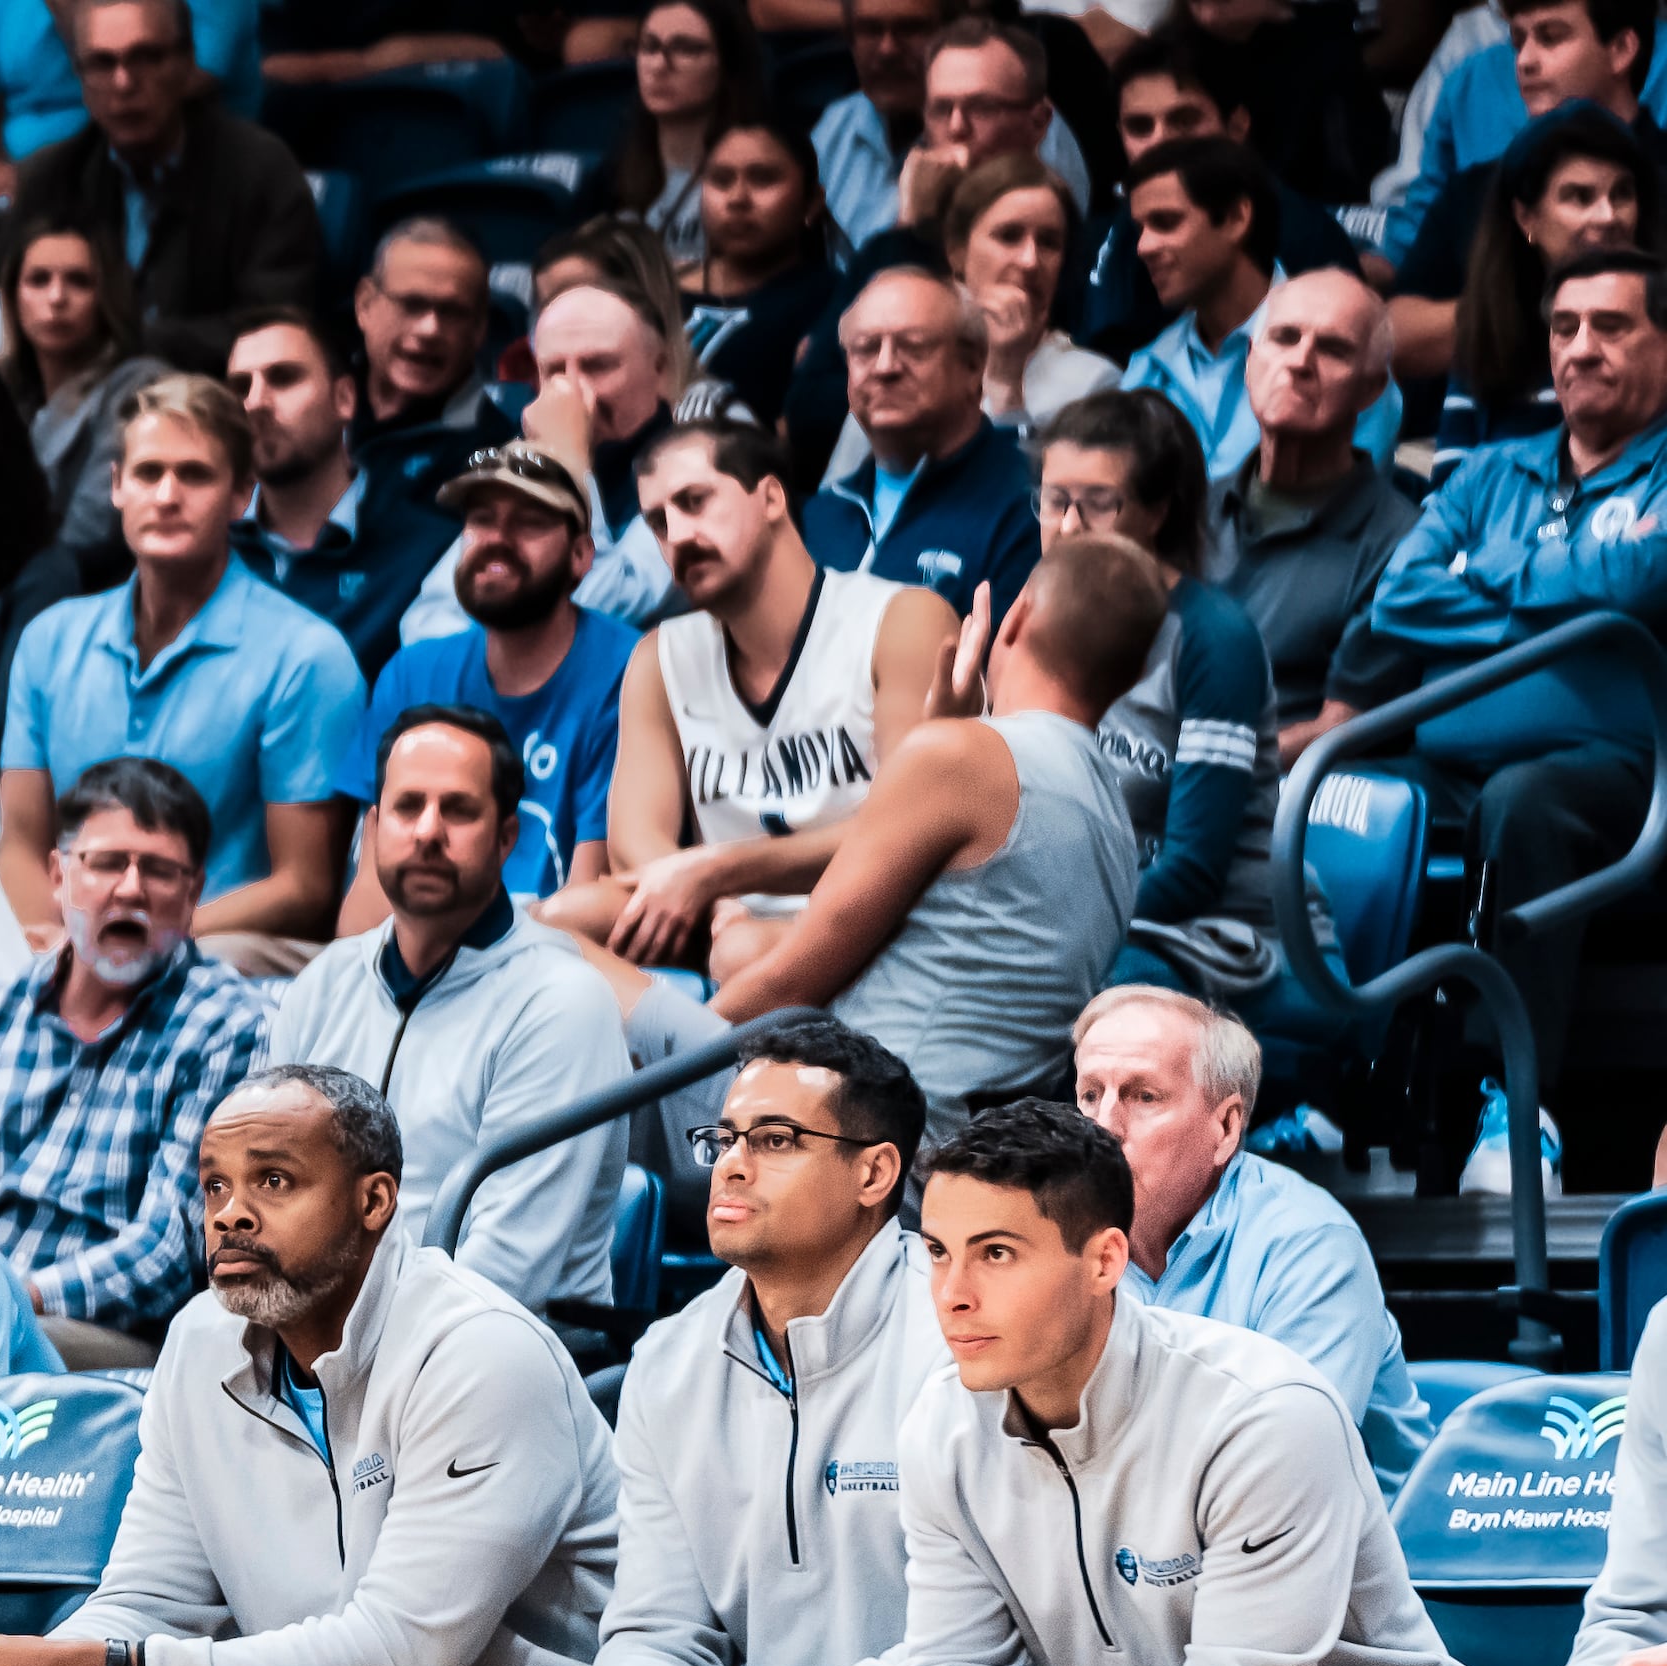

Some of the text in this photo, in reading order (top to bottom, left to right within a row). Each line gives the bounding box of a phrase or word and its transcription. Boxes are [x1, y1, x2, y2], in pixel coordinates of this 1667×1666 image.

[1446, 1471, 1518, 1498] Main
[1518, 1470, 1582, 1498] Line
[1448, 1508, 1501, 1532] Bryn
[1501, 1508, 1563, 1529] Mawr
